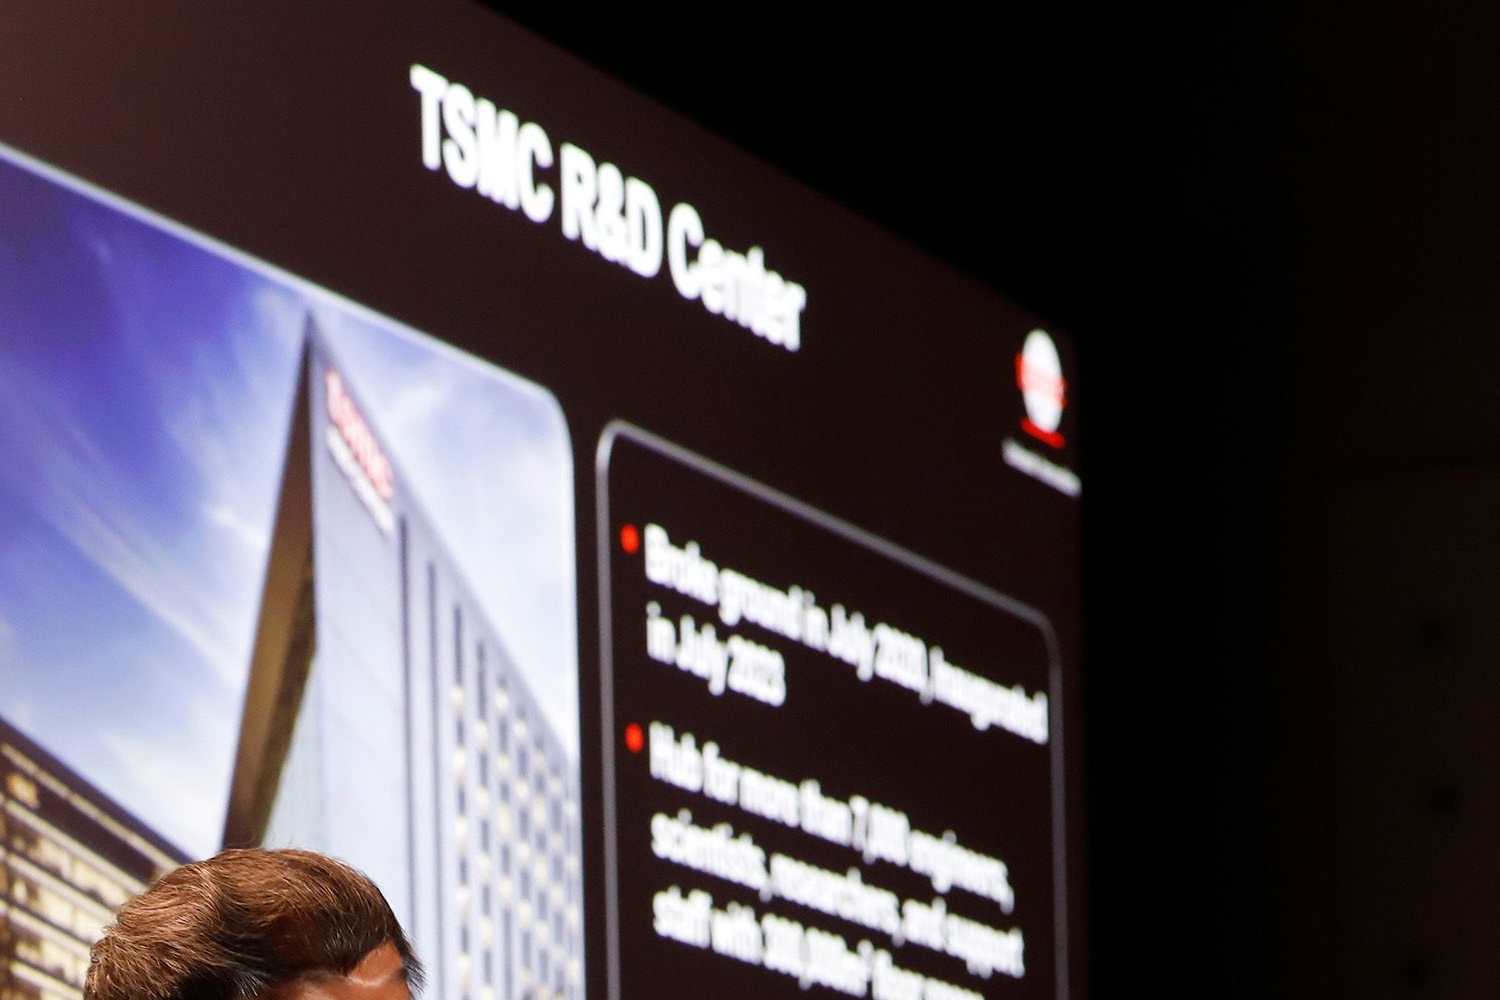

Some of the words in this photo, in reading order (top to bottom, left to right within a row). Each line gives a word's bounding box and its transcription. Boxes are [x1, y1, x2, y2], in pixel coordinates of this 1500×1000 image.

[410, 63, 554, 223] TSMC
[560, 142, 663, 278] R&D
[667, 202, 807, 352] Center
[646, 601, 675, 664] in
[676, 614, 727, 696] July
[719, 568, 801, 641] ground
[802, 590, 829, 651] in
[828, 603, 873, 682] July
[702, 740, 739, 805] for
[739, 766, 799, 827] more
[800, 779, 852, 847] than
